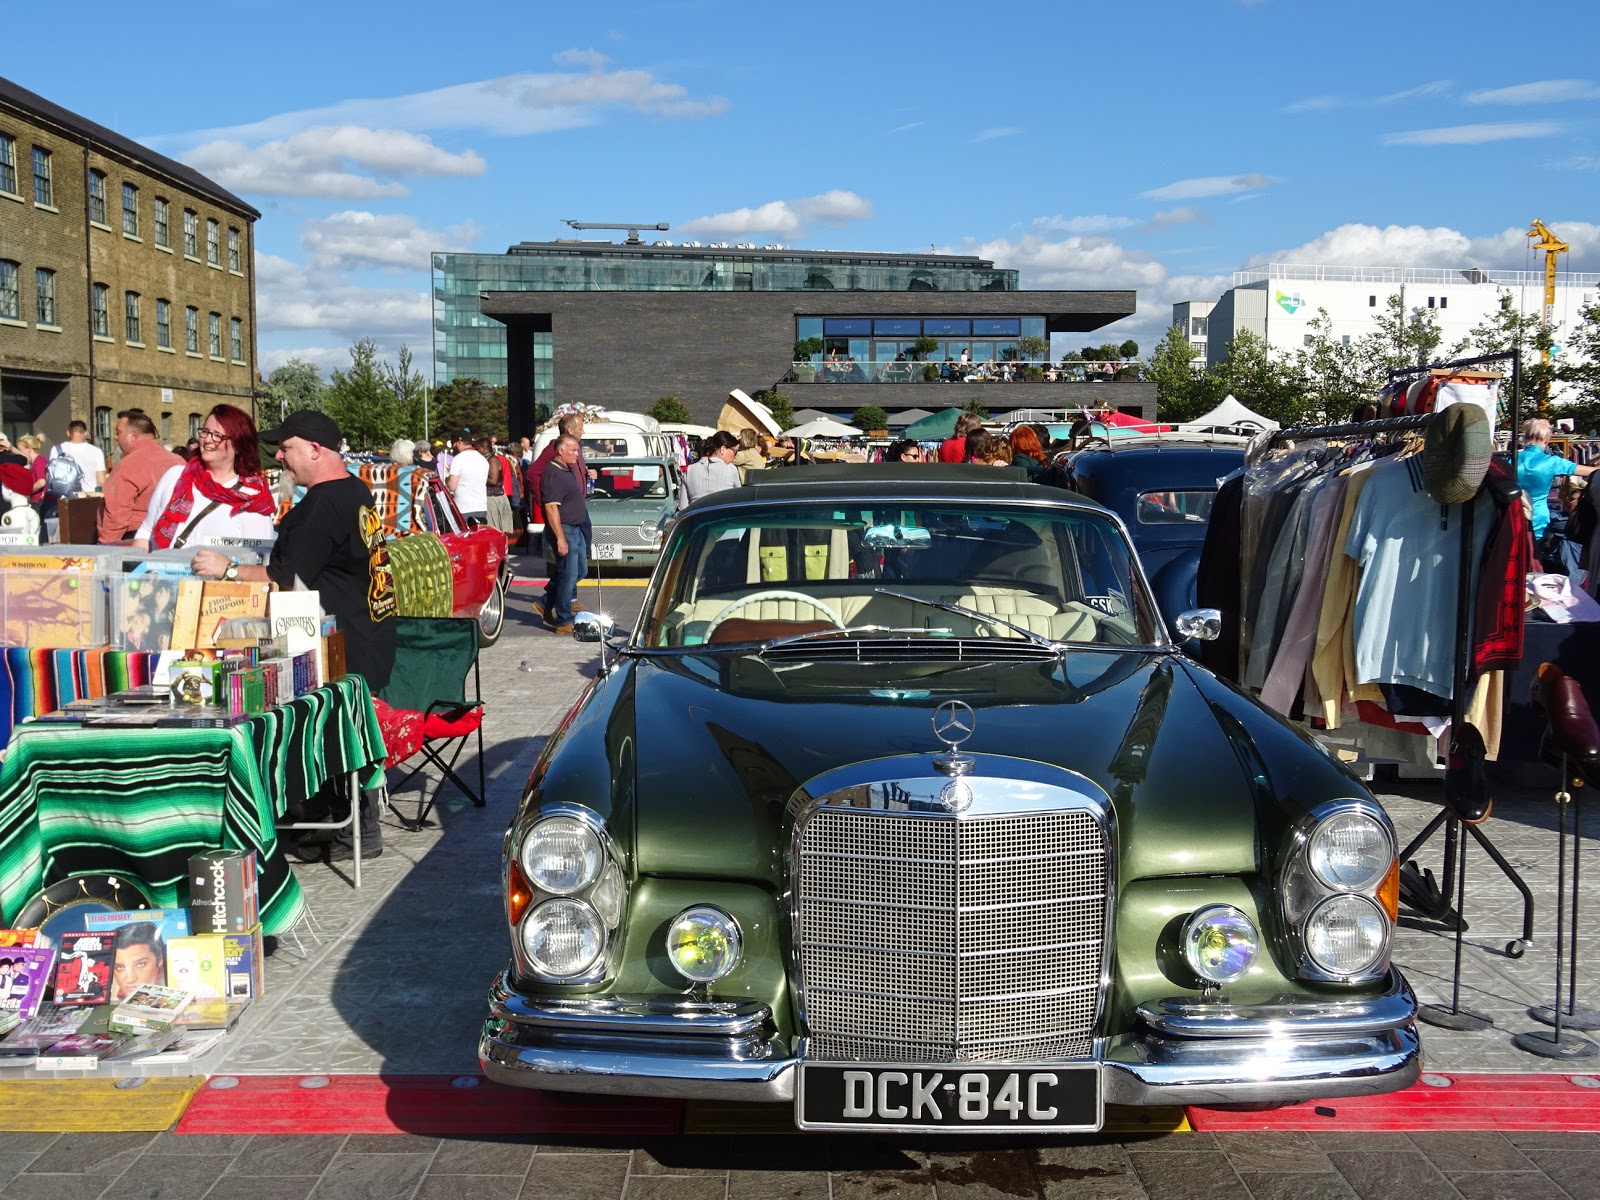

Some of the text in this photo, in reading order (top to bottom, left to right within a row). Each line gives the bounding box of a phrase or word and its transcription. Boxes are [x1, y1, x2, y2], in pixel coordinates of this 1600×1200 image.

[210, 537, 235, 547] ROCK
[243, 540, 262, 548] POP
[599, 551, 614, 559] SCK
[208, 594, 232, 608] FROM
[275, 616, 316, 637] CARPENTERS
[210, 860, 227, 933] Hitchcock
[107, 913, 131, 921] PRESLEY
